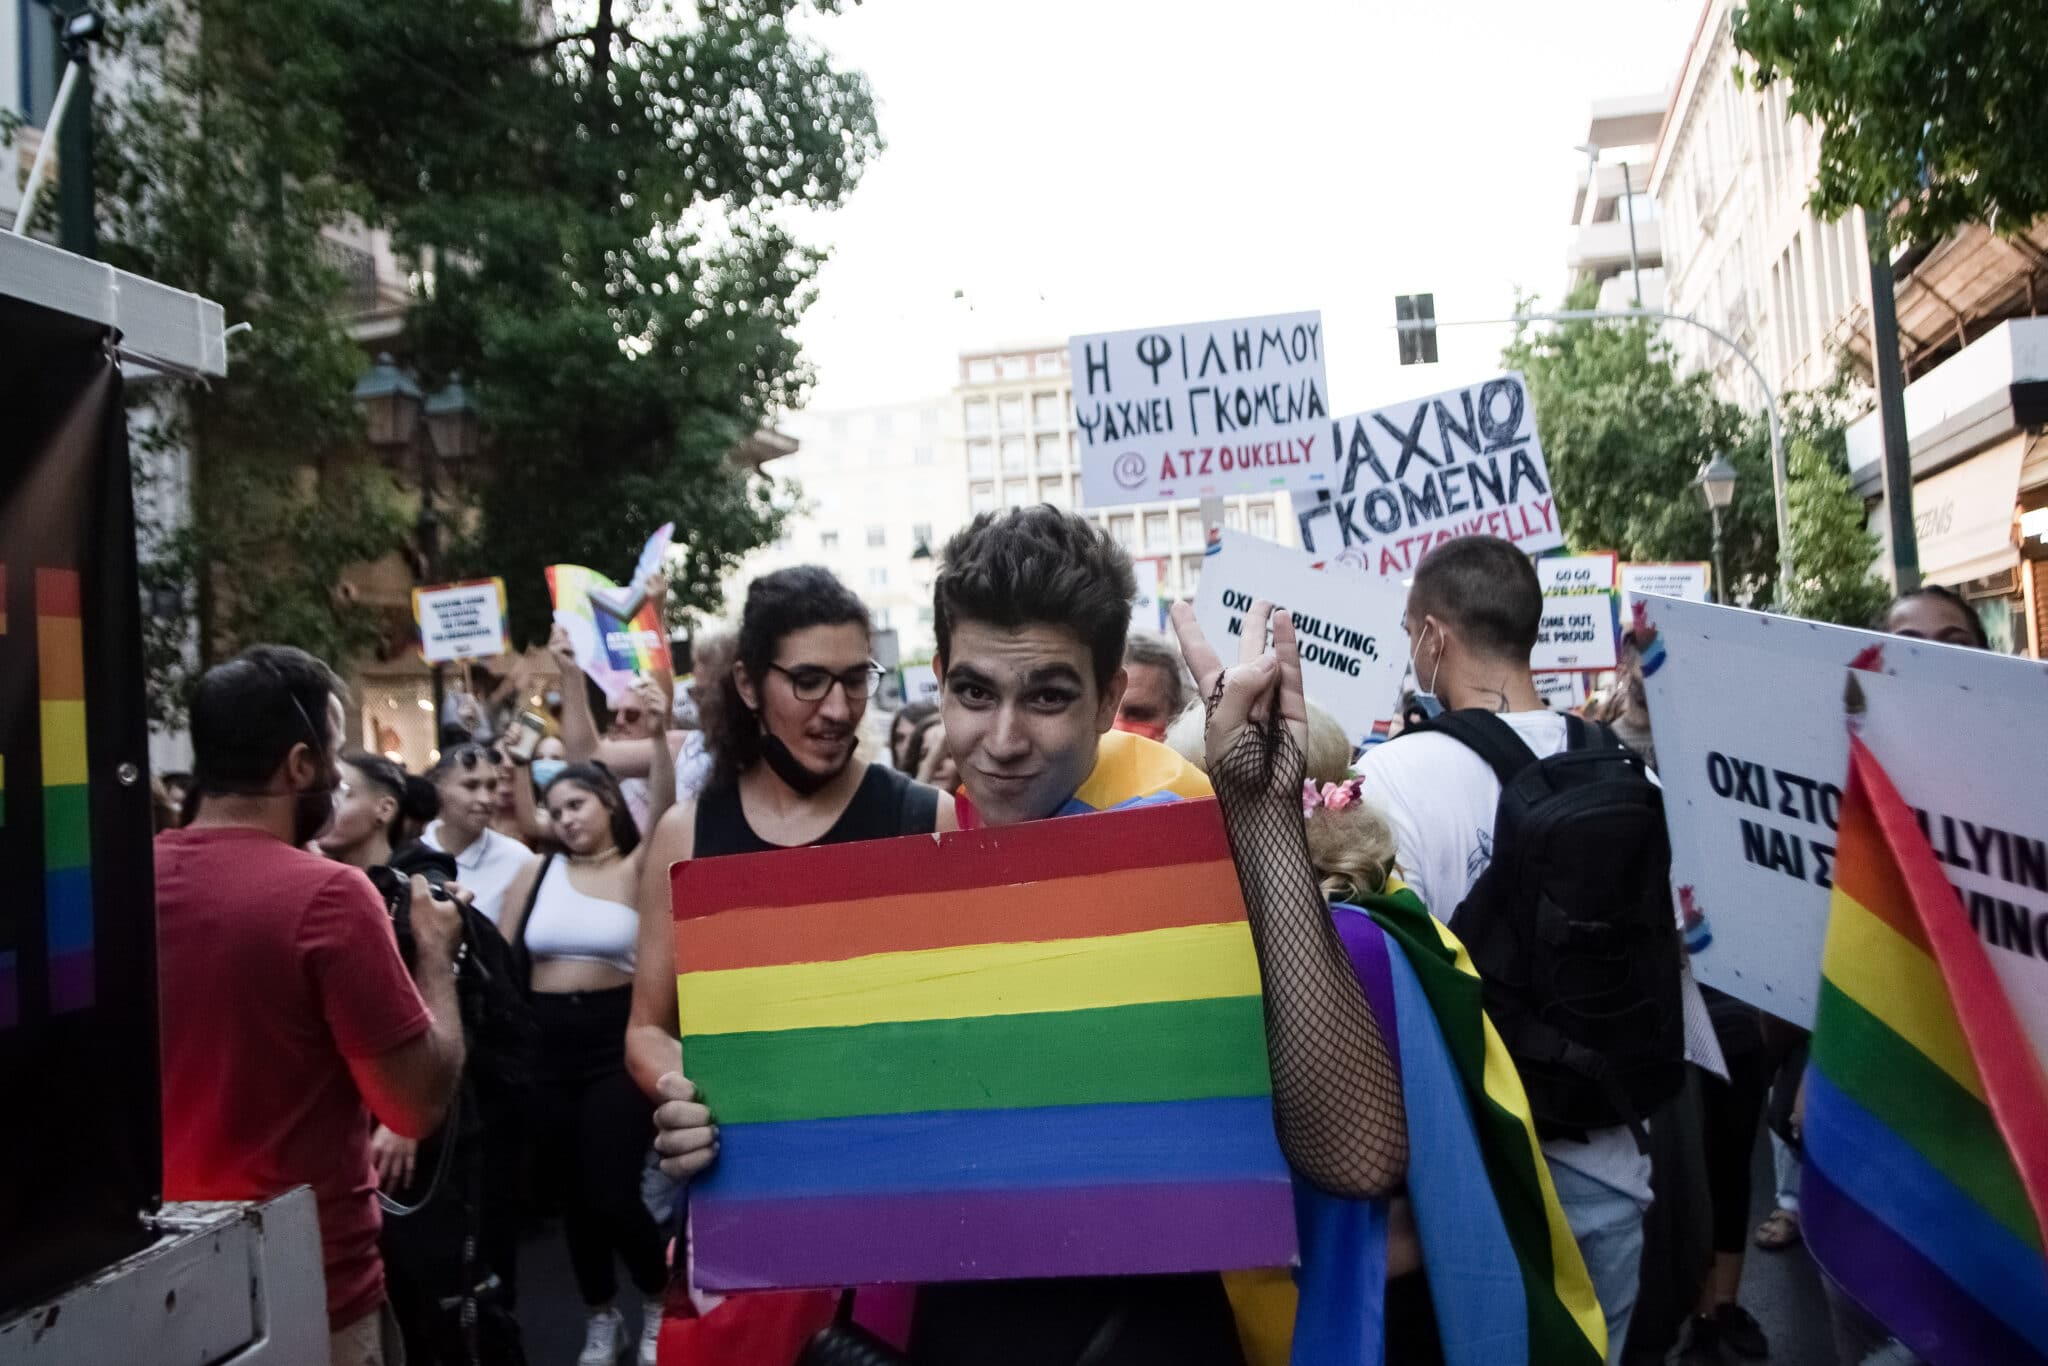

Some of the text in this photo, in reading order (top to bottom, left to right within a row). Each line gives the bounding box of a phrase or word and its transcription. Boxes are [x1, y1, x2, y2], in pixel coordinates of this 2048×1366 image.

[1085, 340, 1112, 395] Η
[1075, 376, 1327, 446] ΨΑΧΝΕΙ ΓΚΟΜΕΝΑ
[1317, 376, 1531, 502] ΑΧΝΩ
[1297, 447, 1549, 554] ΓΚΟΜΕΝΑ
[1291, 611, 1379, 662] BULLYING,
[1297, 640, 1361, 677] LOVING
[1739, 818, 1806, 880] ΝΑΙ
